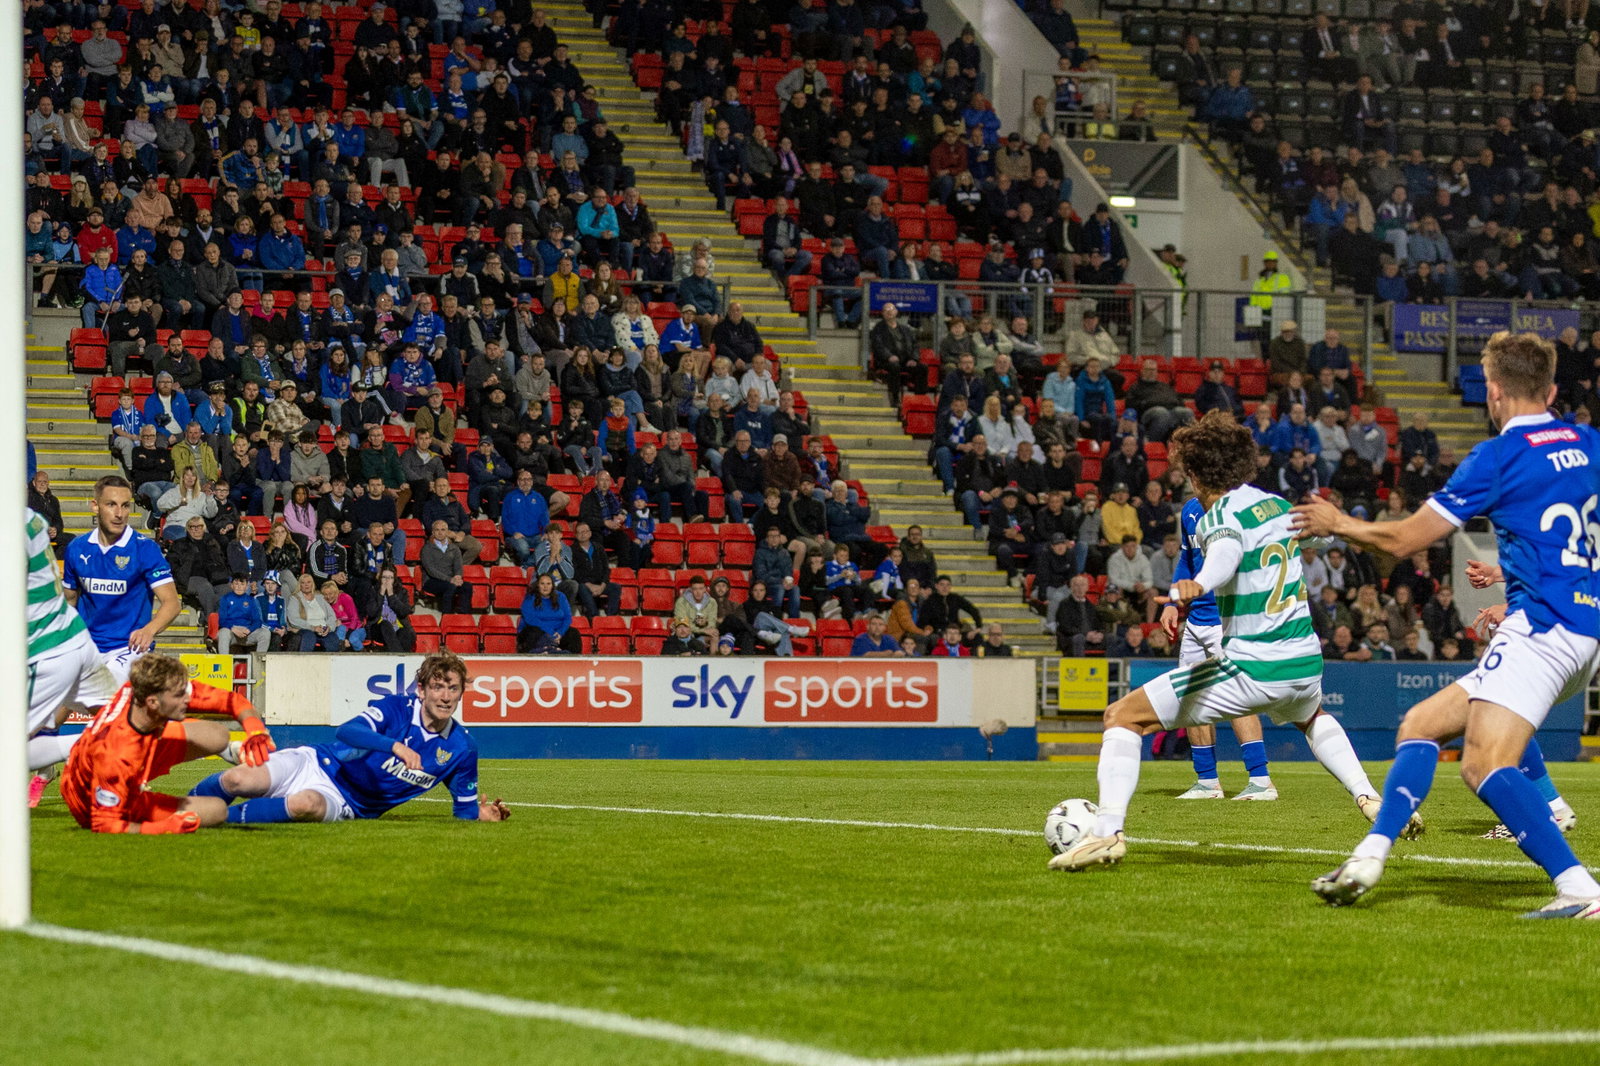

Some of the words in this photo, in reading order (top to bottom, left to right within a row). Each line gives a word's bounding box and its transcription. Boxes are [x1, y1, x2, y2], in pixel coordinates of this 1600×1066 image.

[48, 422, 54, 431] G
[69, 468, 75, 476] F
[1546, 448, 1589, 472] TODD
[1484, 642, 1507, 671] 6
[367, 663, 420, 706] sk
[472, 668, 632, 717] sports
[671, 664, 755, 719] sky
[774, 669, 929, 717] sports
